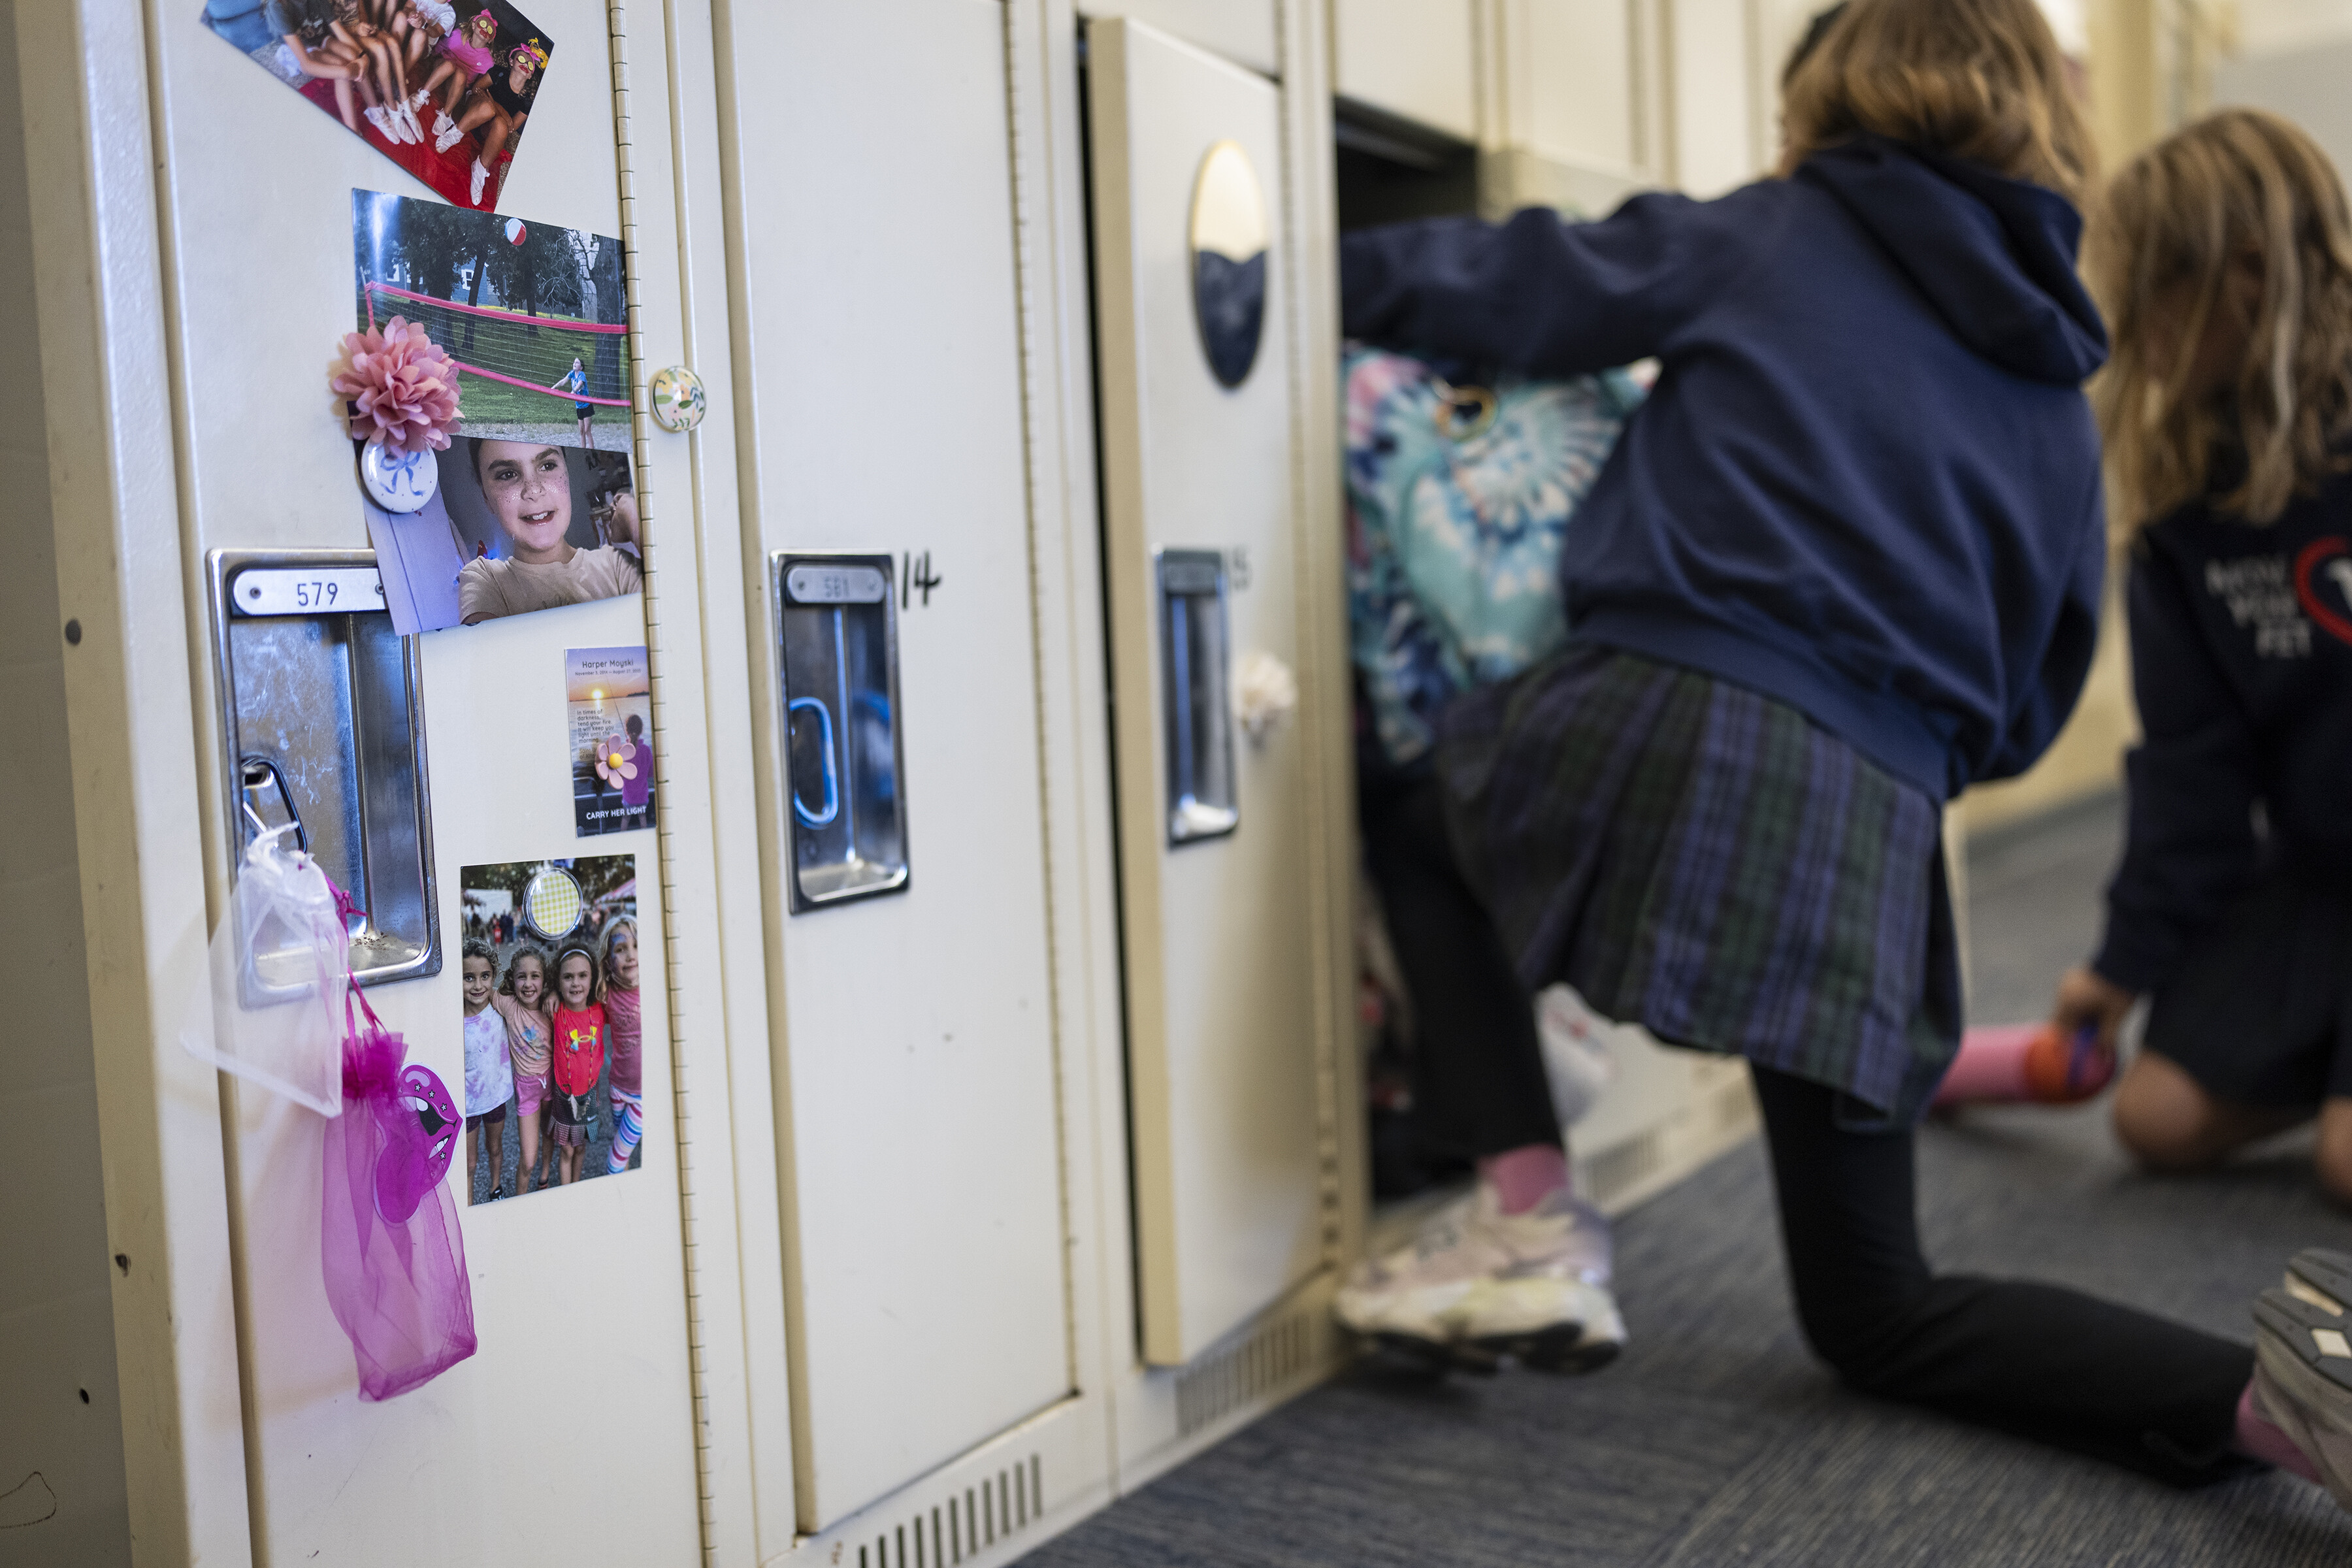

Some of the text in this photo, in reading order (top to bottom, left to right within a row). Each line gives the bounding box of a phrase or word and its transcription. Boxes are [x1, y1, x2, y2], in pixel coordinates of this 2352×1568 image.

[902, 550, 941, 610] 14
[297, 582, 338, 606] 579
[582, 659, 634, 669] Harper Moyski
[586, 804, 647, 820] CARRY HER LIGHT
